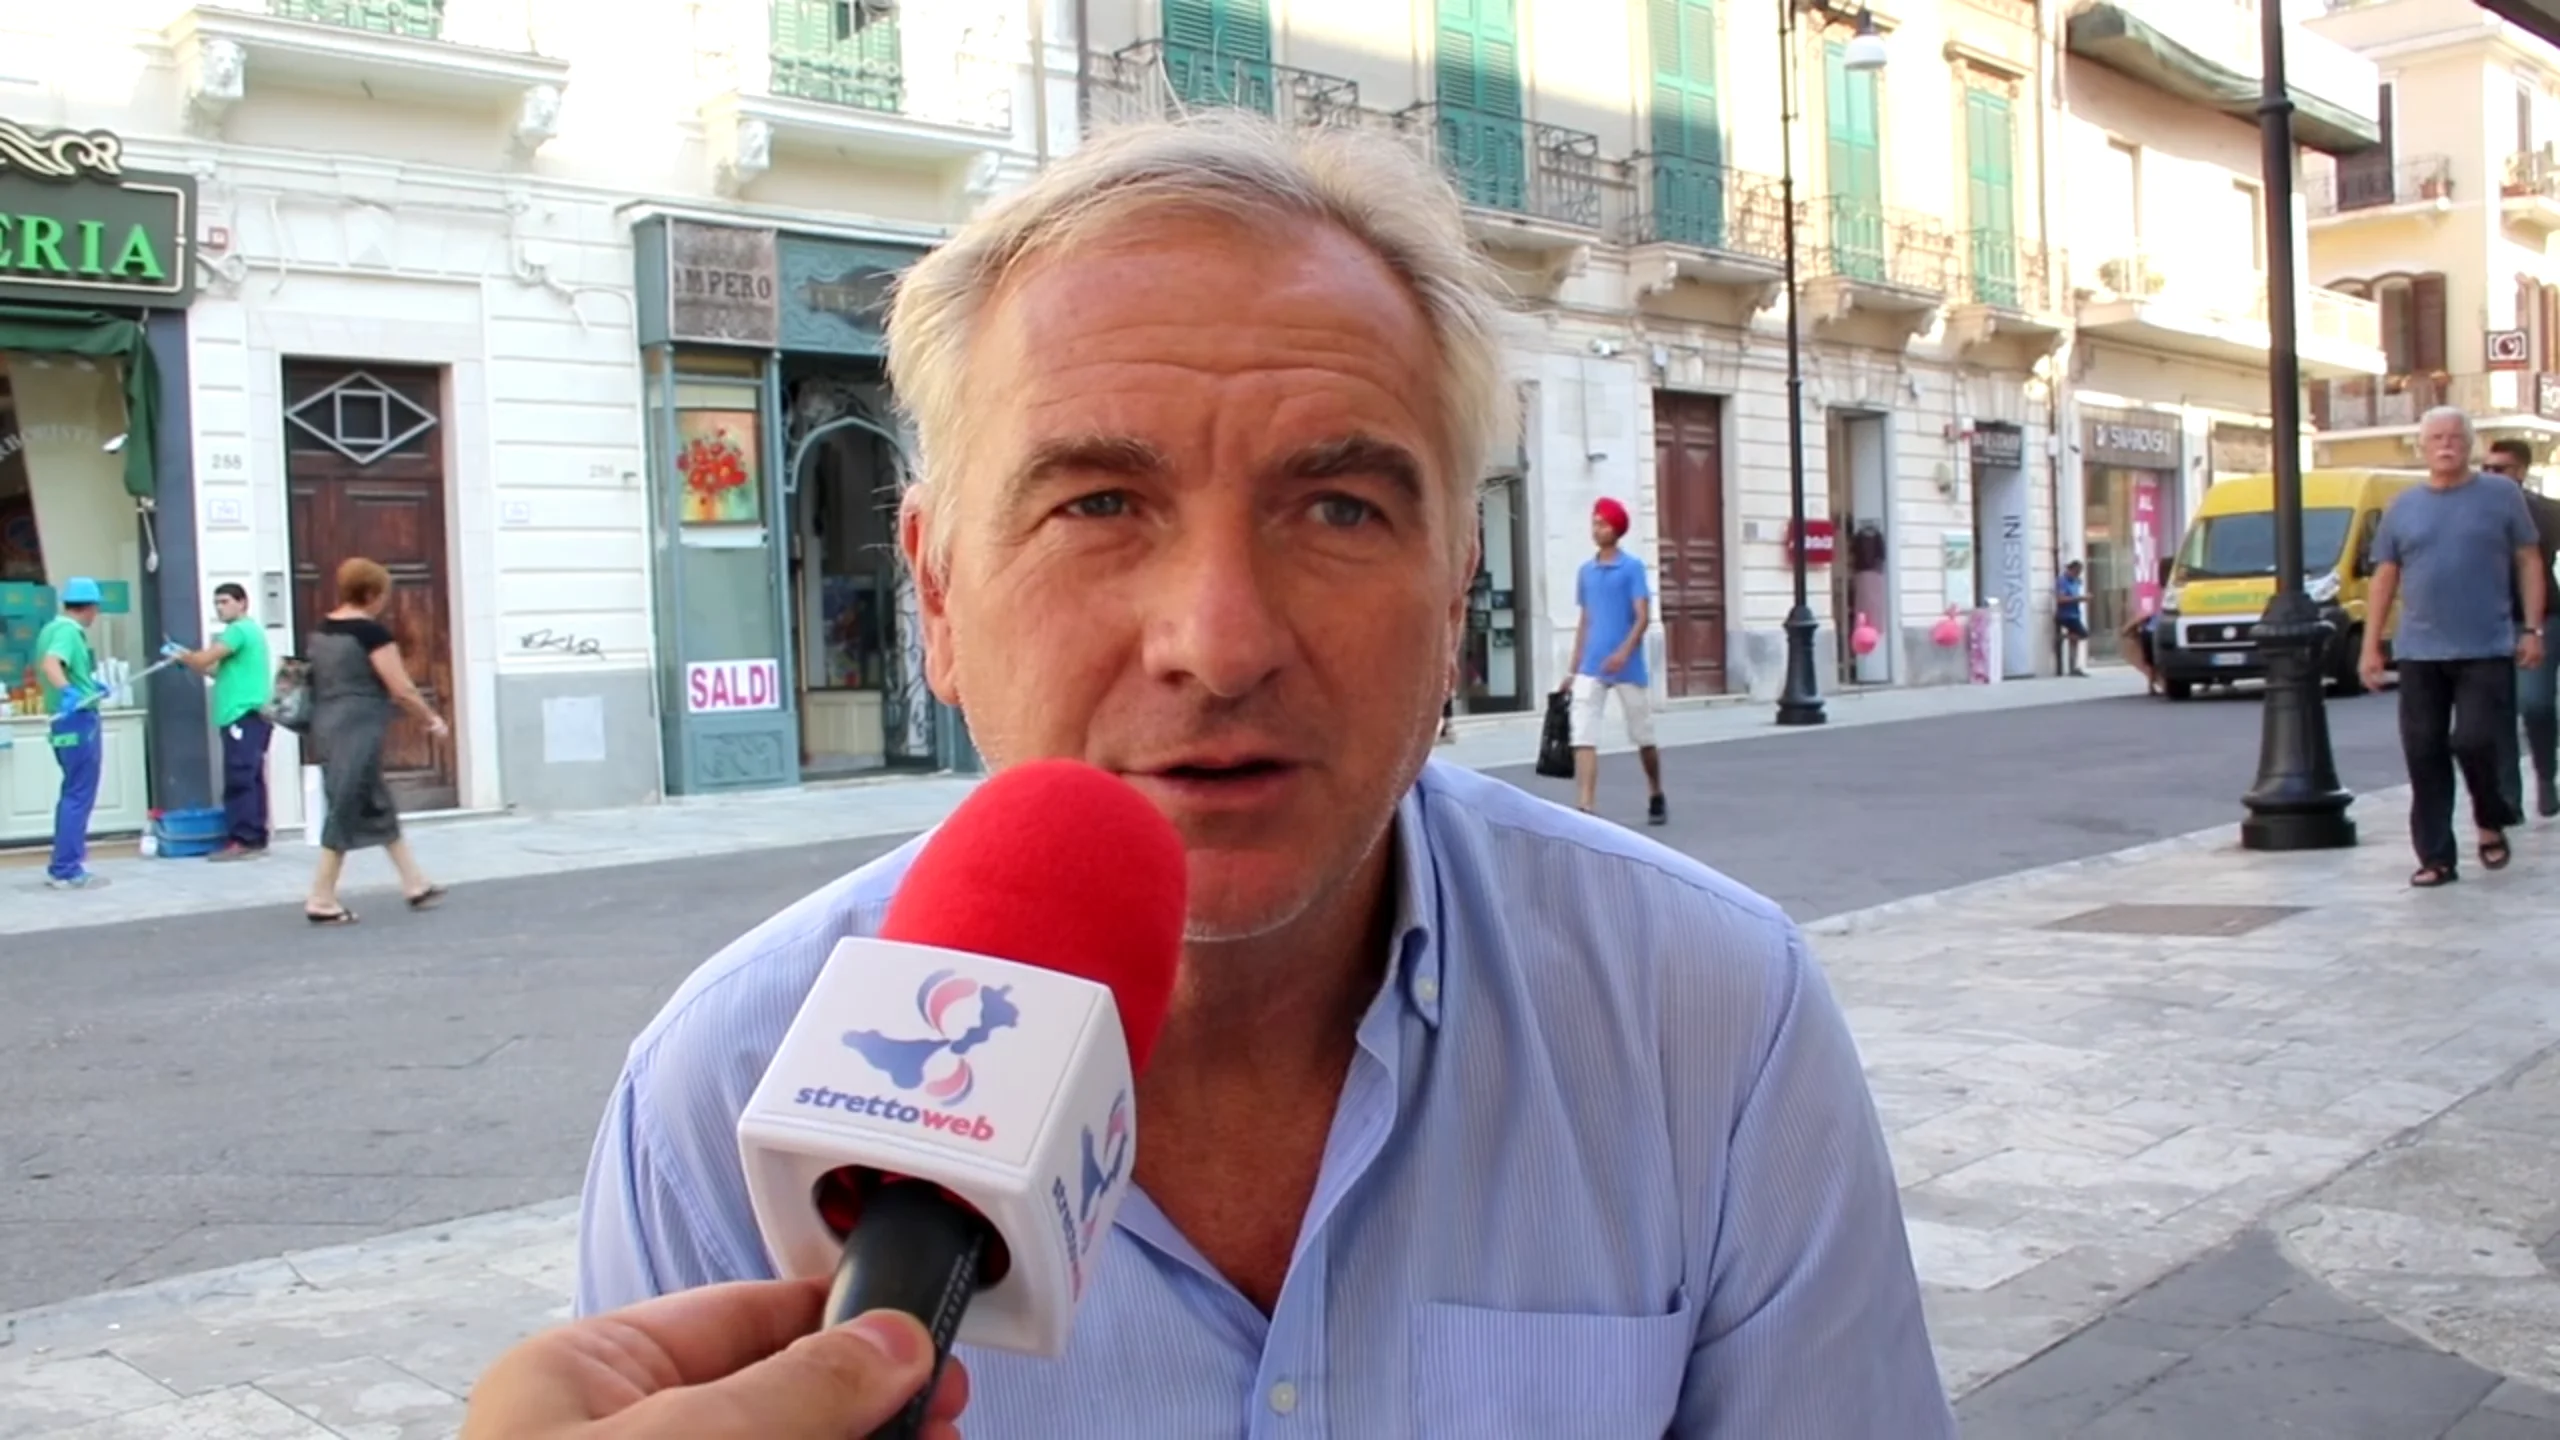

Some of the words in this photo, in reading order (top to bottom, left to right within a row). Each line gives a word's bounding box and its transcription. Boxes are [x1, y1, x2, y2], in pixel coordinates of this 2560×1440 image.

[691, 664, 776, 709] SALDI
[794, 1085, 995, 1142] strettoweb
[1053, 1175, 1083, 1305] stretto
